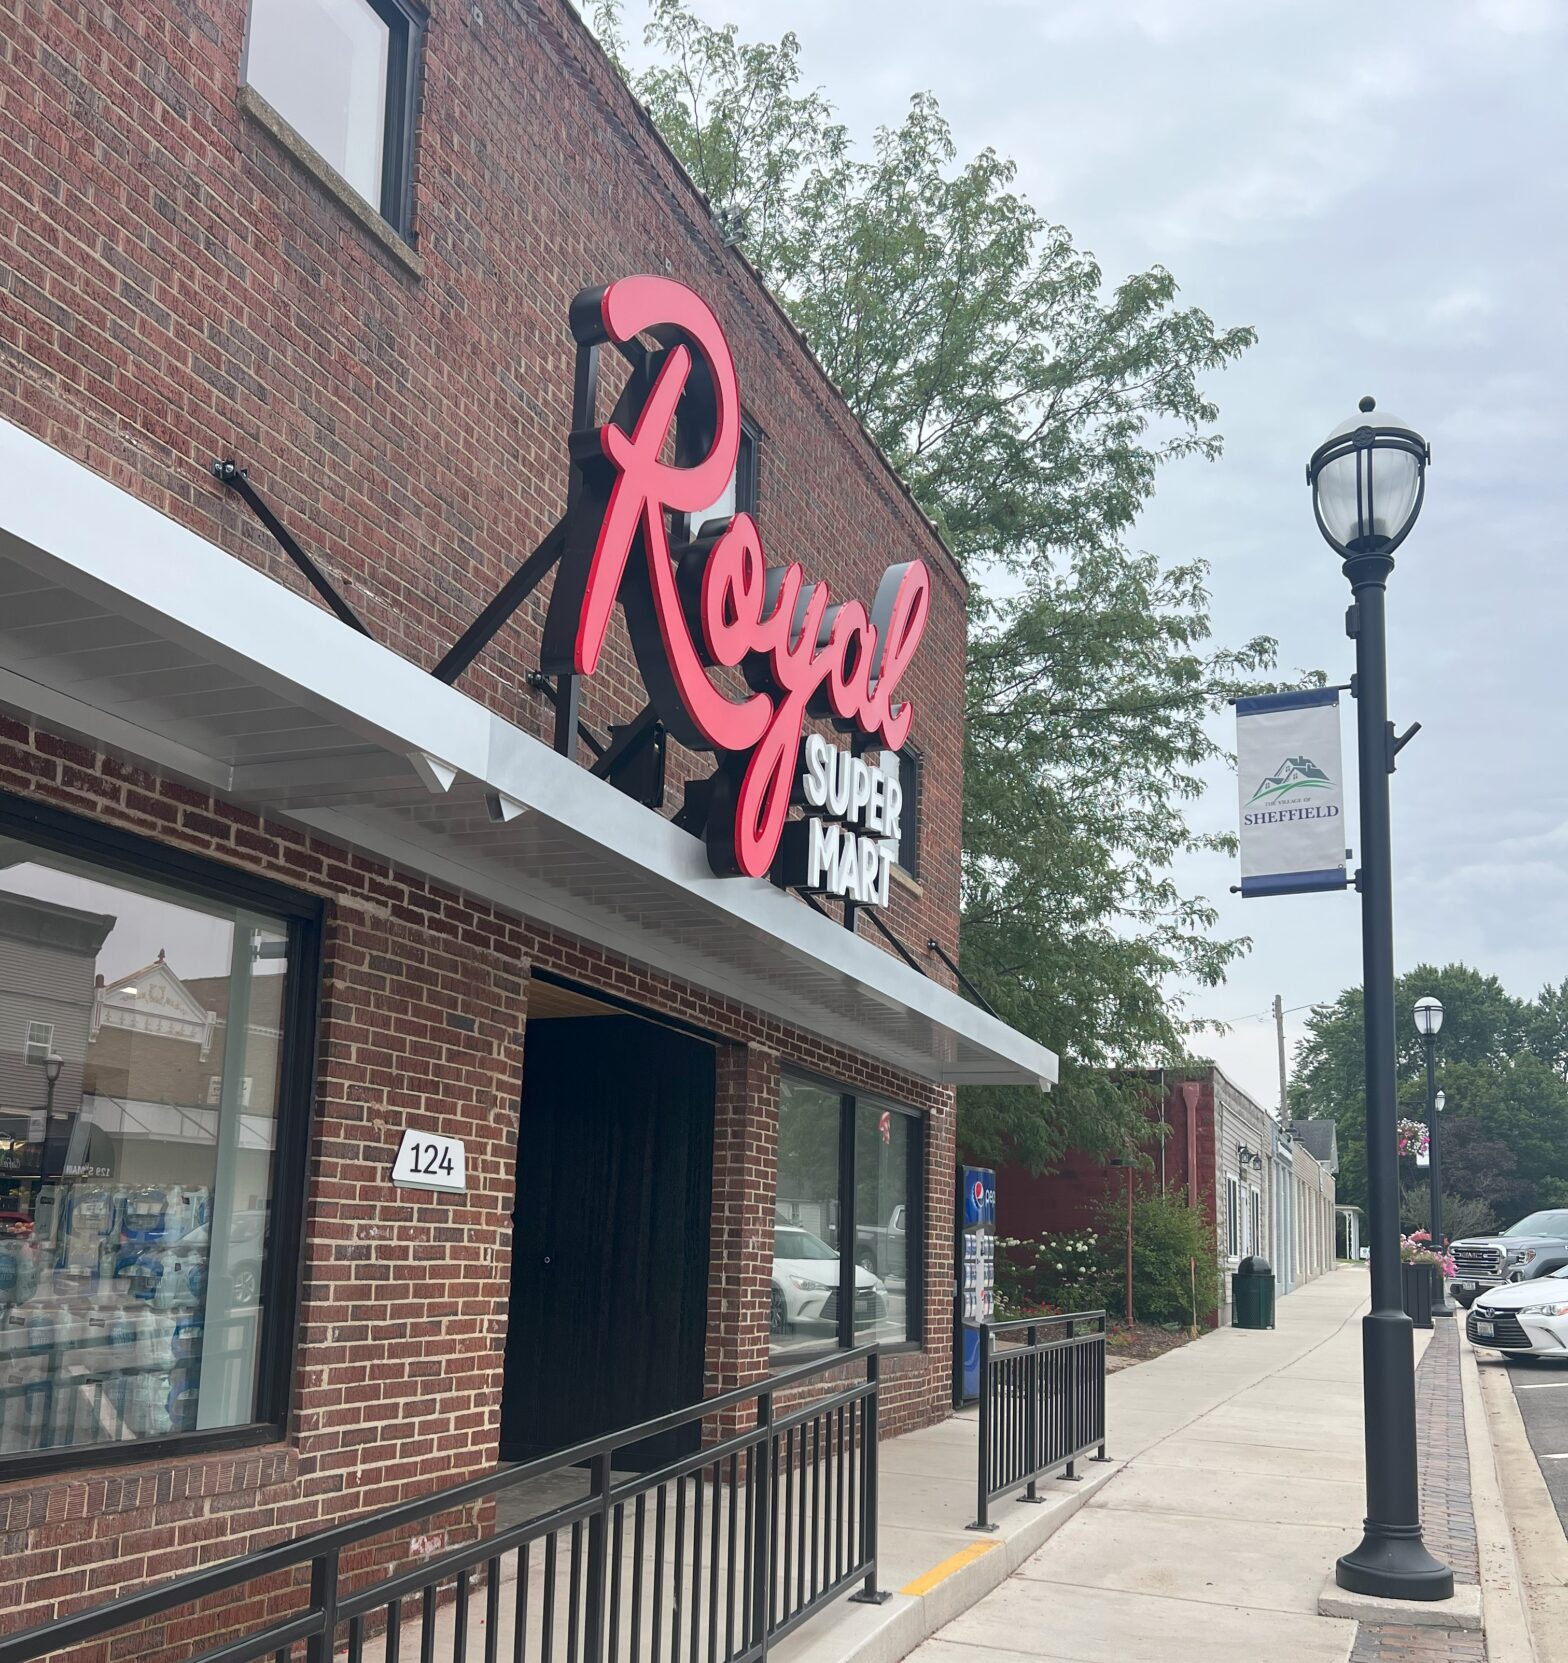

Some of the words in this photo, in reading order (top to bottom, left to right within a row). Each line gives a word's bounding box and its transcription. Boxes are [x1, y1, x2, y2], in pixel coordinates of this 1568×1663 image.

[573, 273, 932, 879] Royal
[803, 733, 903, 840] SUPER
[1244, 806, 1339, 825] SHEFFIELD
[807, 816, 895, 909] MART
[410, 1143, 454, 1176] 124
